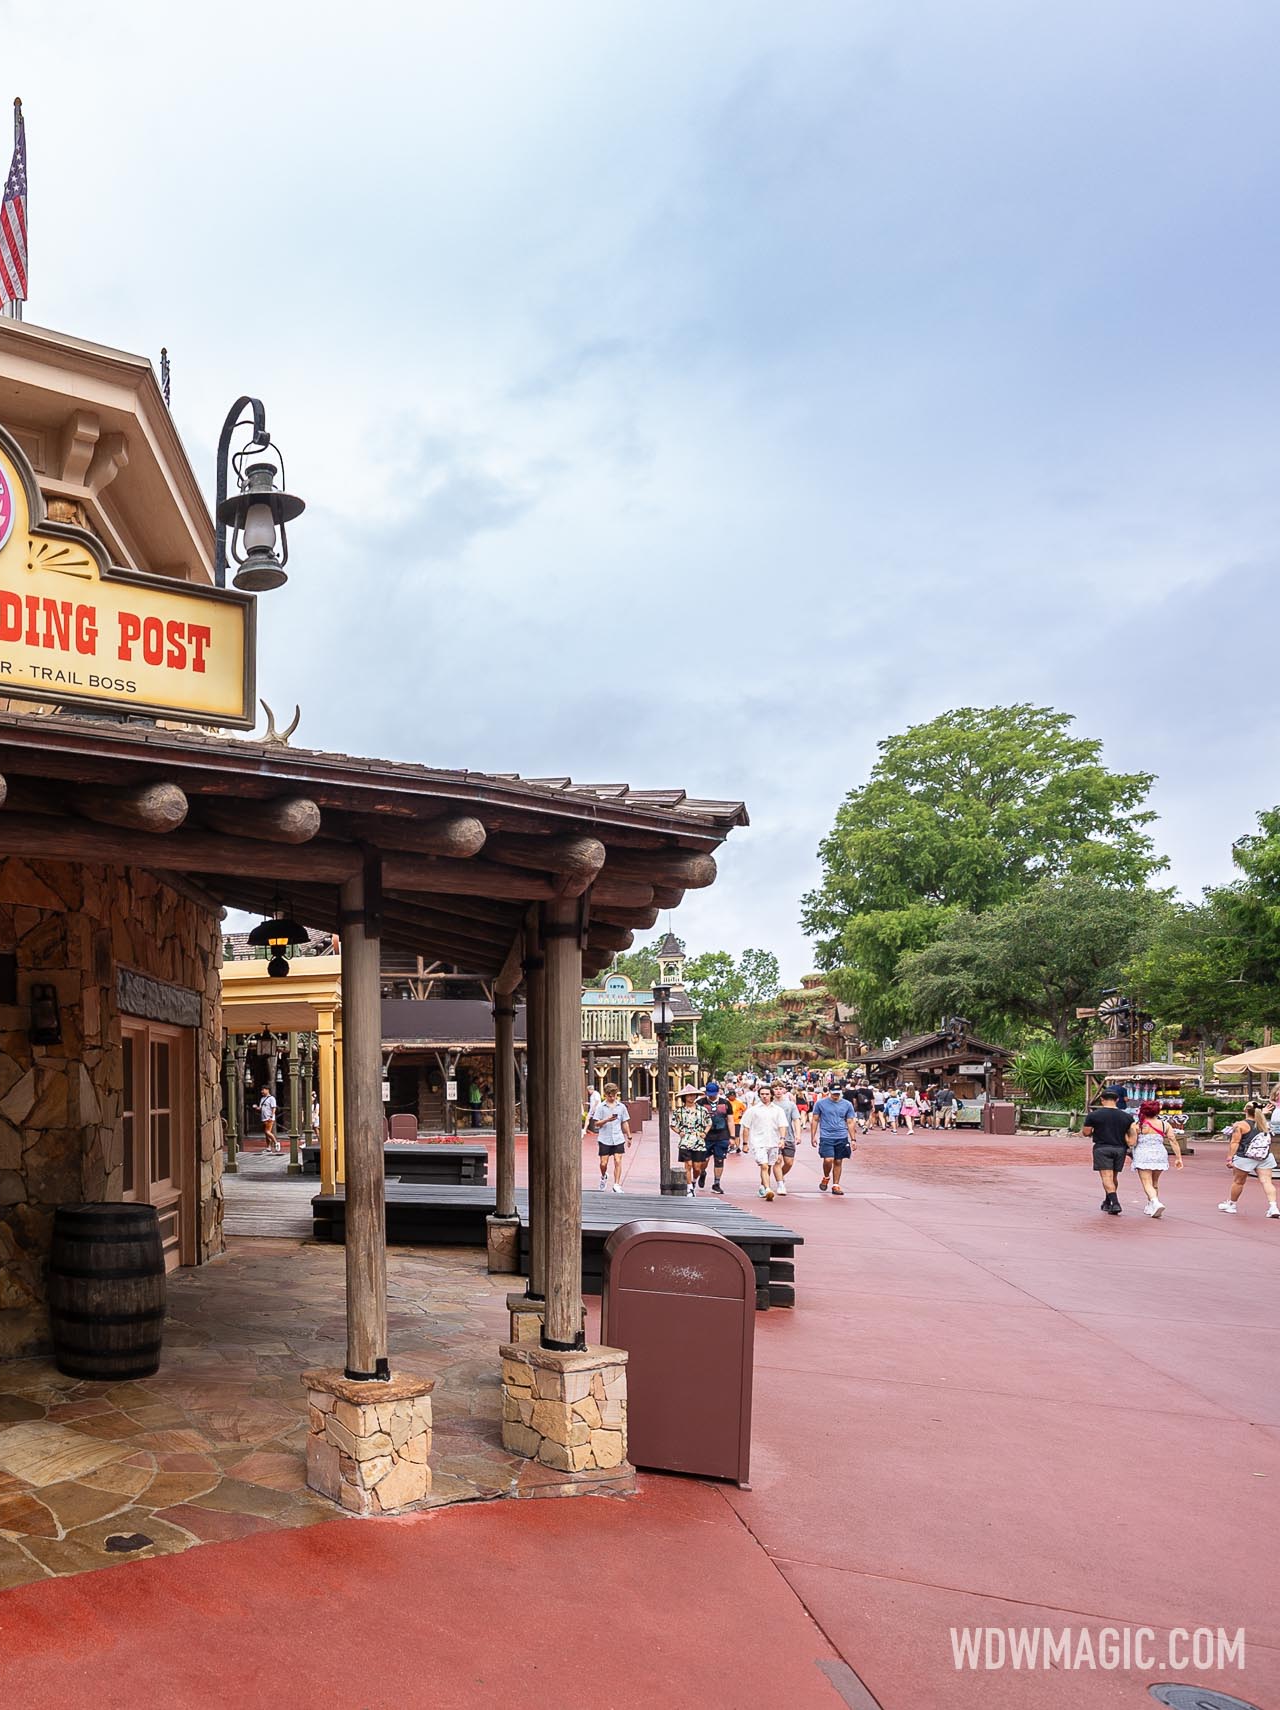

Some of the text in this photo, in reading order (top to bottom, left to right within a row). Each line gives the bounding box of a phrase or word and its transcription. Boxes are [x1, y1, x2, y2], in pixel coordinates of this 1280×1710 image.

[118, 611, 211, 674] POST
[30, 665, 83, 685] TRAIL
[89, 675, 137, 693] BOSS
